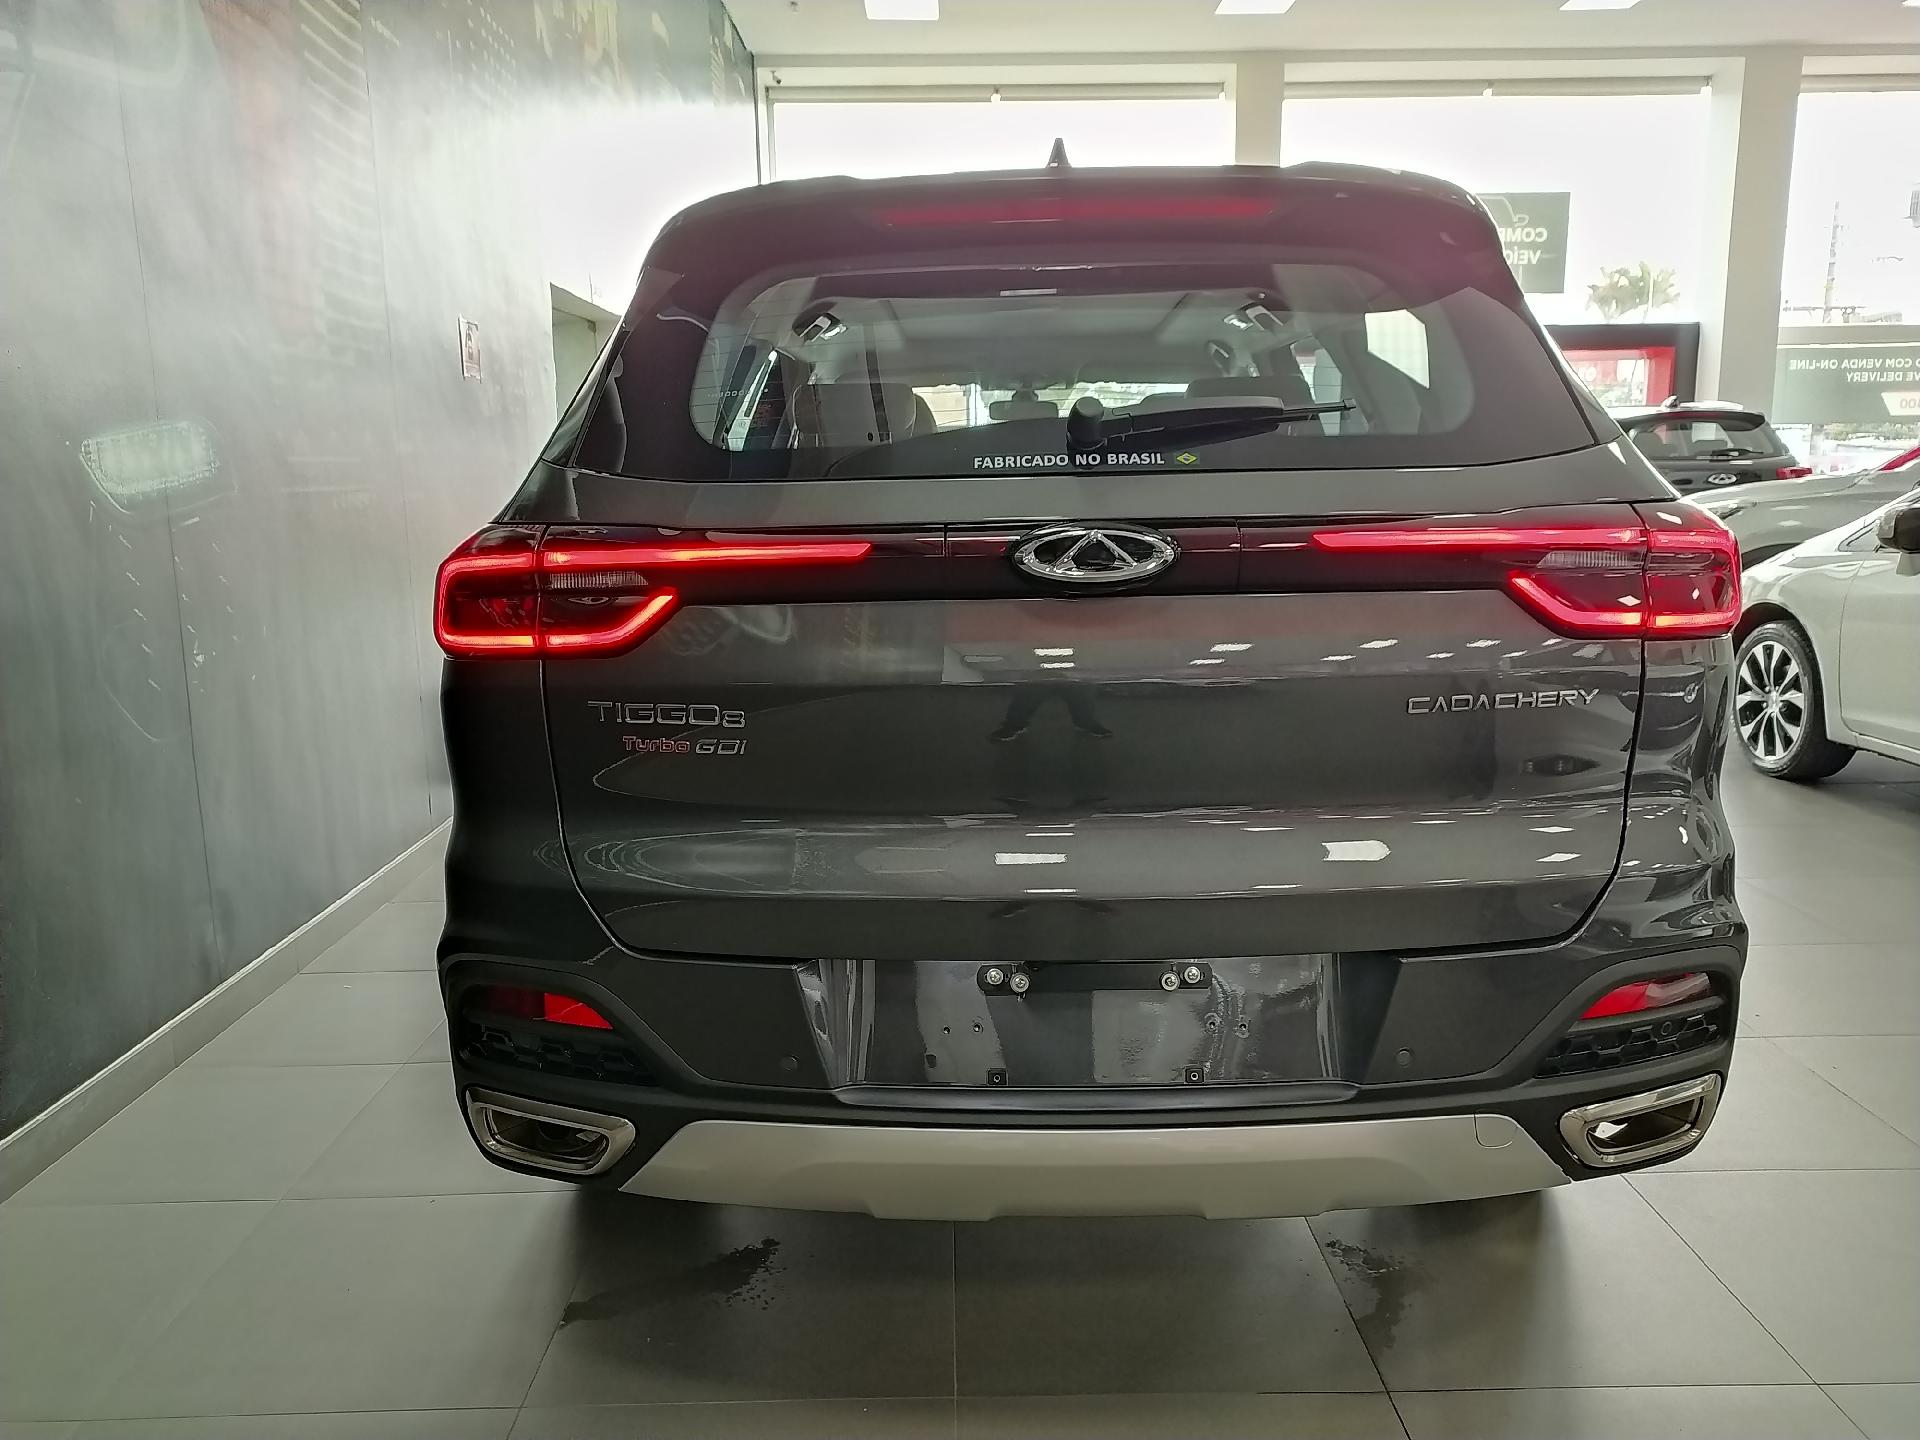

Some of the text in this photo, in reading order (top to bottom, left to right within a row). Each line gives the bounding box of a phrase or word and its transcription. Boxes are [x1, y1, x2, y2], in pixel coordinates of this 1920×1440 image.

[973, 452, 1165, 469] FABRICADO NO BRASIL
[622, 735, 691, 753] Turbo
